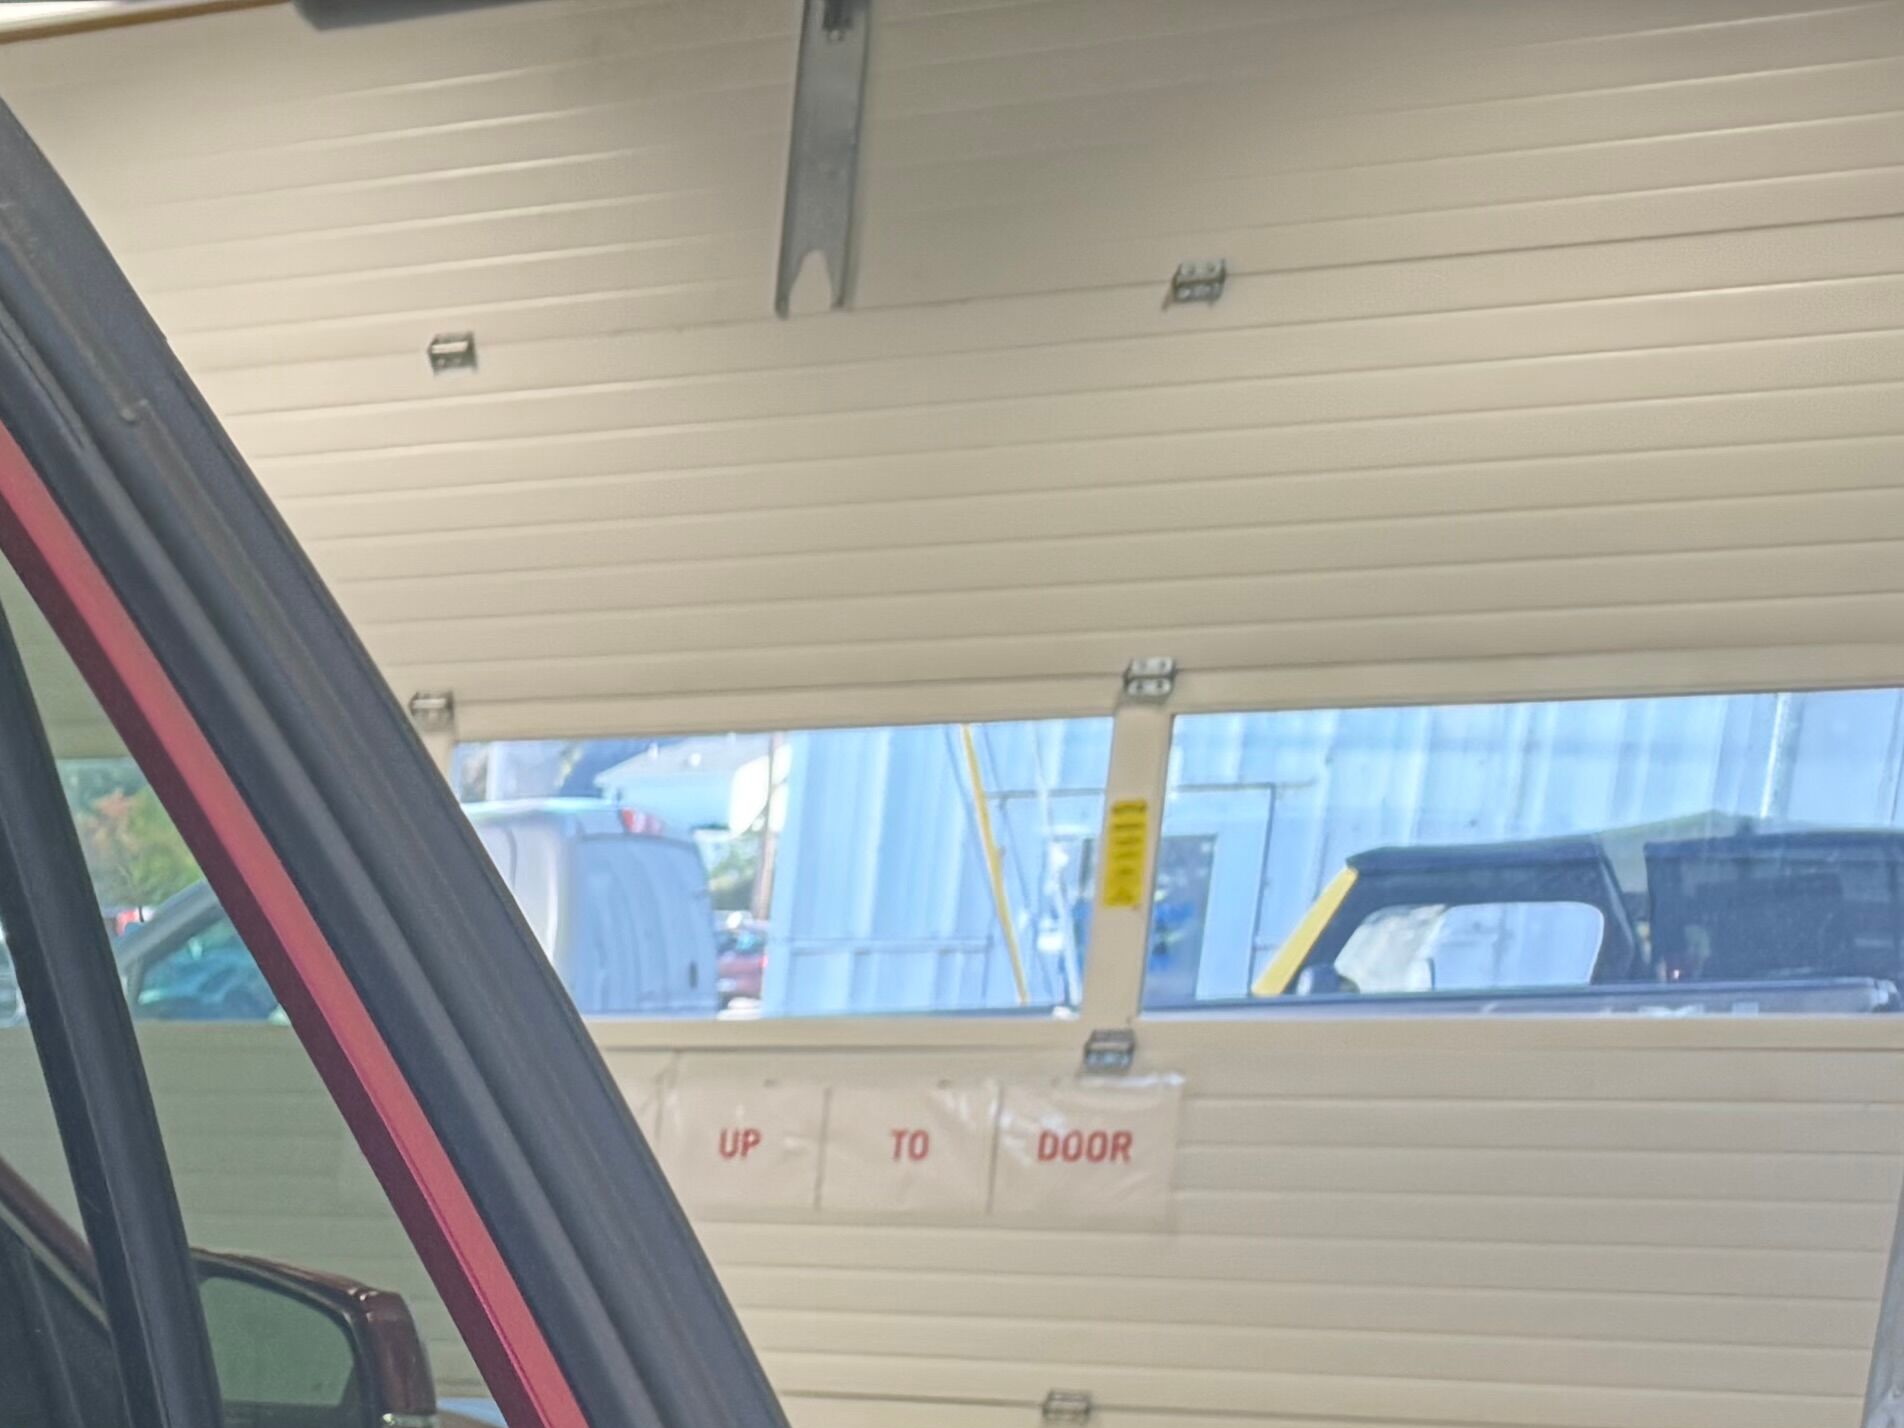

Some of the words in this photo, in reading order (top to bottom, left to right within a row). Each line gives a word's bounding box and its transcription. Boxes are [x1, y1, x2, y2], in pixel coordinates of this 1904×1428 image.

[718, 1129, 761, 1160] UP
[891, 1130, 929, 1161] TO
[1037, 1131, 1133, 1163] DOOR
